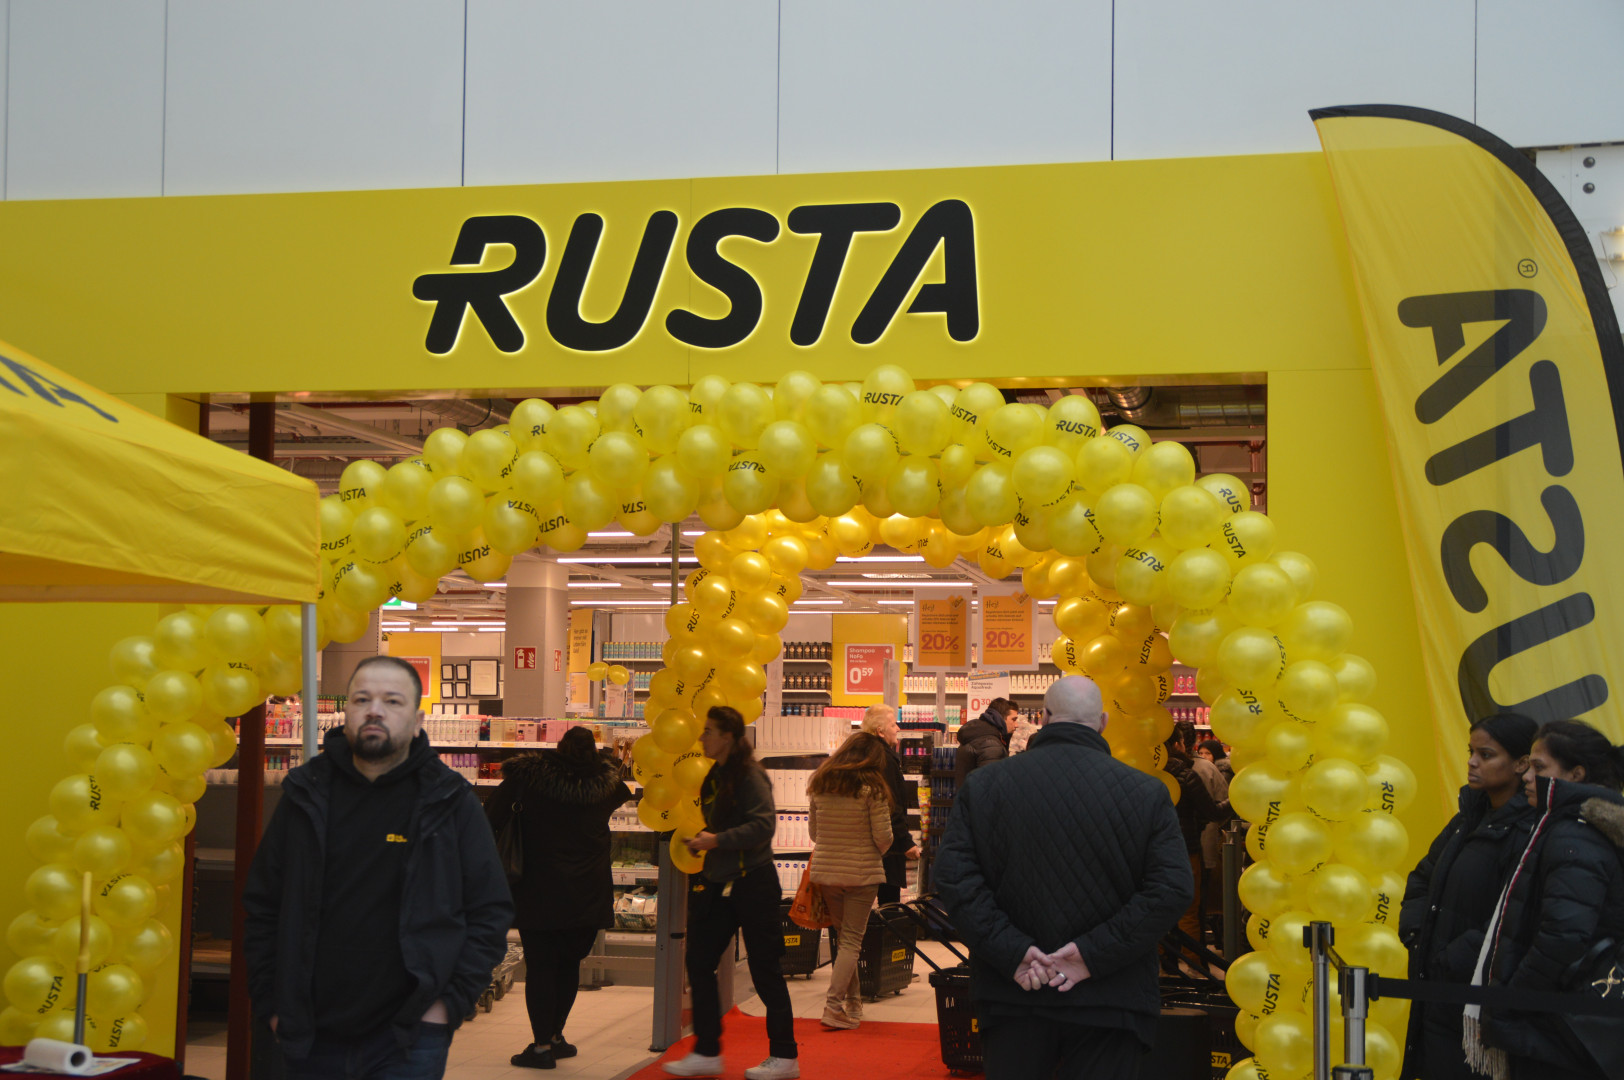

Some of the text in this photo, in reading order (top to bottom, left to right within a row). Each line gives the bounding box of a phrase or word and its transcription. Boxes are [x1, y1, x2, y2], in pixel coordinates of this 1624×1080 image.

[412, 199, 979, 354] RUSTA
[1056, 419, 1097, 438] RUSTA
[340, 488, 366, 502] USTA
[622, 501, 647, 514] STA
[1218, 487, 1243, 514] RUS
[508, 500, 540, 521] USTA
[321, 534, 352, 551] RUST
[1222, 522, 1247, 559] RUSTA
[1124, 548, 1165, 572] RUSTA
[686, 608, 700, 633] RUS
[921, 634, 959, 650] 20%
[985, 631, 1025, 648] 20%
[1139, 635, 1155, 665] RUSTA
[1157, 675, 1168, 705] RUST
[1237, 688, 1263, 715] RUS
[89, 775, 101, 811] RUST
[1381, 781, 1394, 814] RUS
[1266, 801, 1281, 825] STA
[1375, 892, 1390, 924] RUS
[37, 975, 63, 1014] RUSTA
[1262, 974, 1280, 1015] RUSTA
[109, 1017, 125, 1048] USTA
[1211, 1055, 1228, 1064] STA
